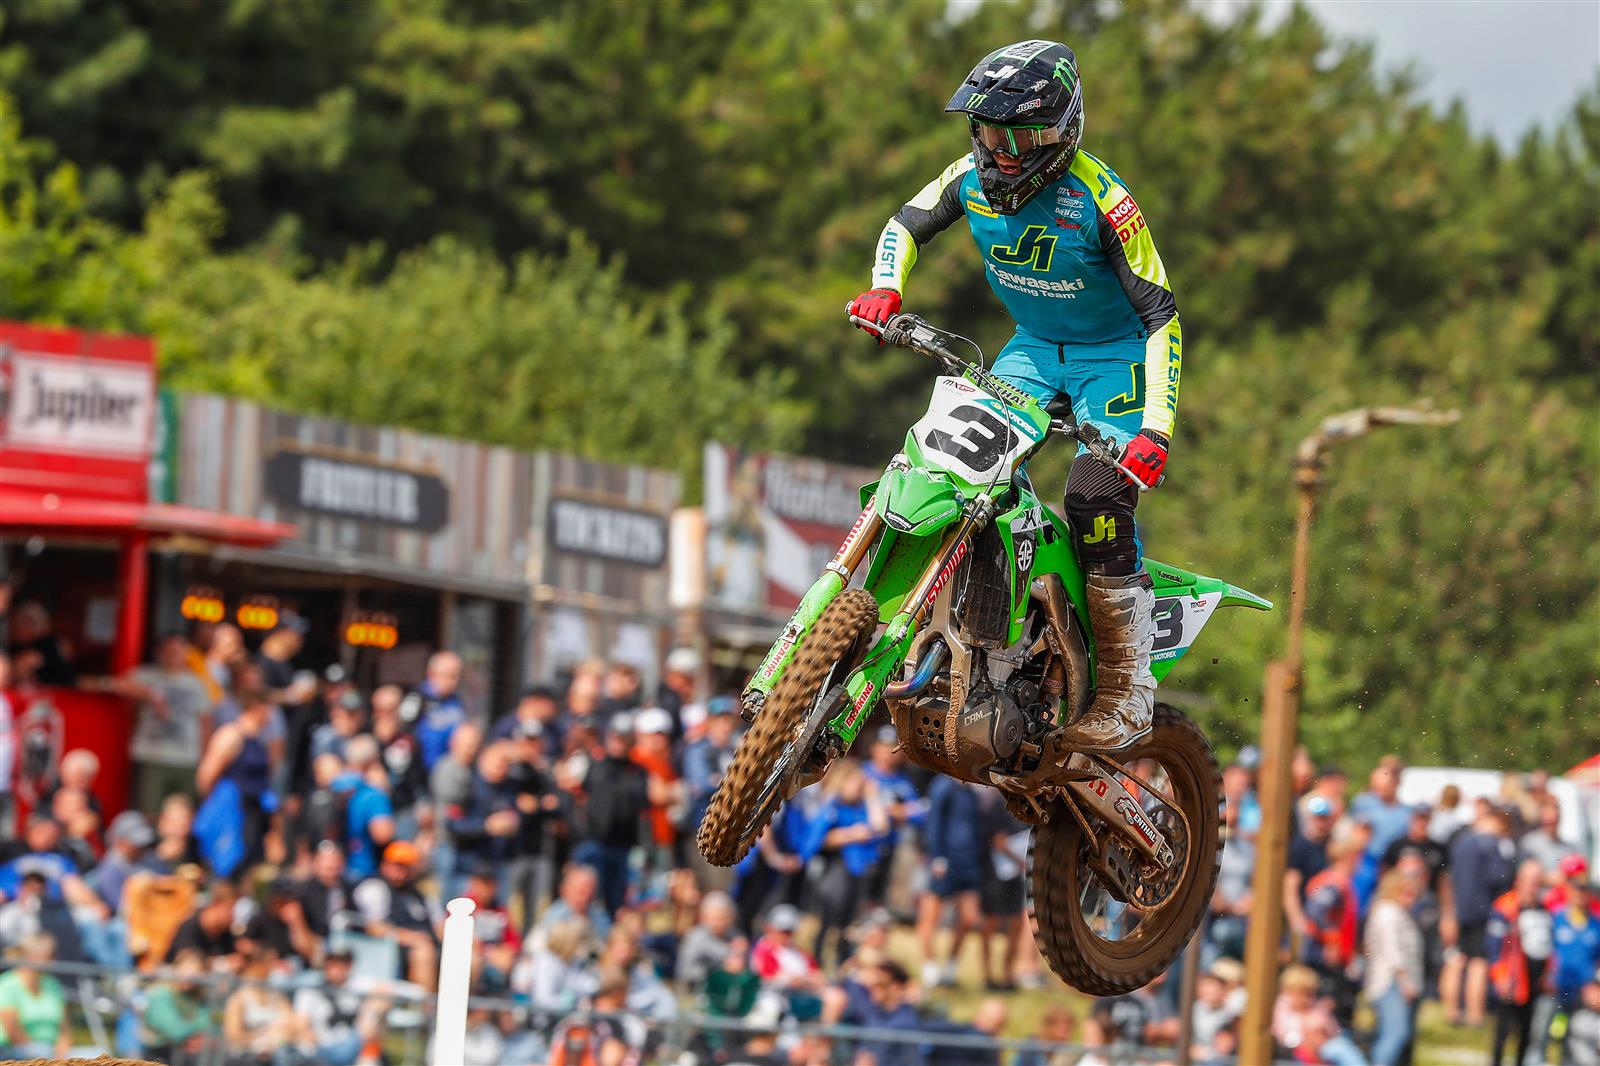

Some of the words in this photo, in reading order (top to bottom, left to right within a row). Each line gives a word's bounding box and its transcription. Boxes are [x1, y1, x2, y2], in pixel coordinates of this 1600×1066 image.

[1108, 197, 1135, 223] NGK
[985, 259, 1085, 292] Kawasaki
[999, 277, 1039, 297] Racing
[1039, 289, 1076, 299] Team
[942, 379, 976, 394] MXGP
[1166, 333, 1180, 416] JUST1
[924, 404, 1020, 473] 3
[1000, 408, 1041, 439] MOTOREX
[1156, 570, 1183, 584] Kawasaki
[1150, 597, 1184, 651] 3
[763, 640, 794, 679] RAKING
[1154, 650, 1177, 661] MOTOREX
[845, 682, 874, 726] BRAKING
